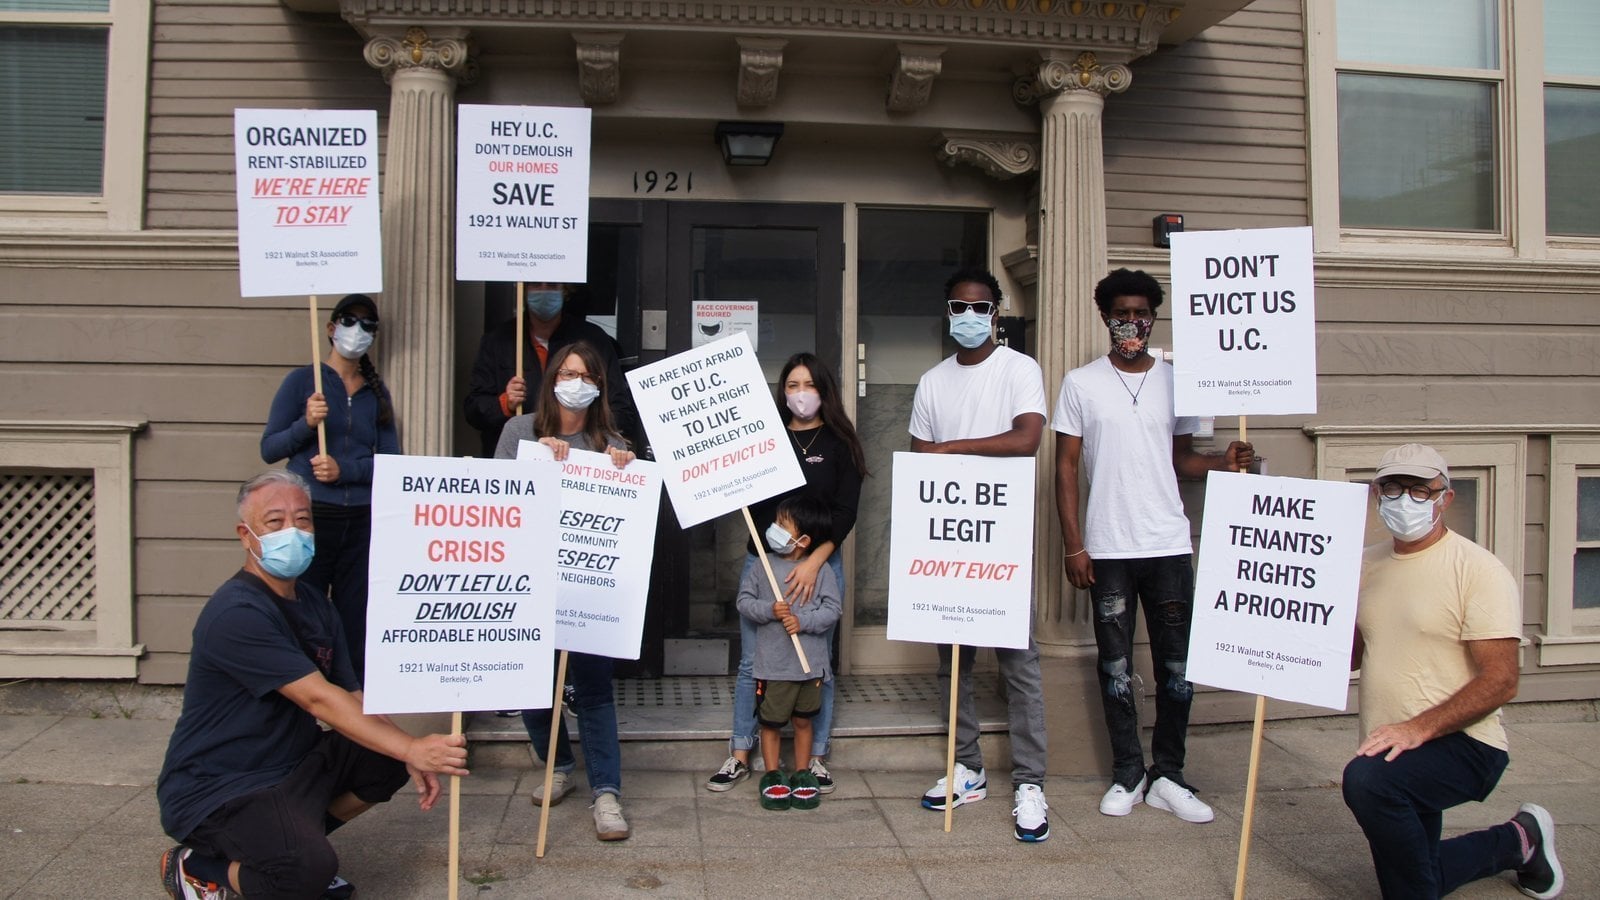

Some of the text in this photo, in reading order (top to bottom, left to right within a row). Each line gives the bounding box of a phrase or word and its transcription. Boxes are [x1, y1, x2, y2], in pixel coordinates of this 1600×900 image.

[246, 127, 367, 146] ORGANIZED
[491, 121, 557, 138] HEY U.C.
[475, 143, 573, 157] DON'T DEMOLISH
[248, 156, 367, 169] RENT-STABILIZED
[489, 161, 558, 174] OUR HOMES
[255, 178, 371, 196] WE'RE HERE
[633, 170, 693, 194] 1921
[492, 182, 554, 206] SAVE
[277, 206, 352, 224] TO STAY
[469, 215, 578, 229] 1921 WALNUT ST
[265, 251, 283, 259] 1921
[310, 250, 318, 258] St
[529, 252, 566, 260] Association
[1205, 255, 1279, 279] DON'T
[1190, 290, 1296, 316] EVICT US
[1219, 328, 1267, 351] U.C.
[638, 346, 743, 390] WE ARE NOT AFRAID
[671, 373, 726, 400] OF U.C.
[1198, 380, 1216, 388] 1921
[1243, 379, 1251, 387] St
[1252, 379, 1292, 387] Association
[659, 383, 750, 423] WE HAVE A RIGHT
[682, 406, 741, 437] TO LIVE
[672, 420, 765, 460] IN BERKELEY TOO
[682, 438, 775, 482] DON'T EVICT US
[402, 476, 535, 496] BAY AREA IS IN A
[593, 468, 646, 486] DISPLACE
[694, 466, 778, 500] 1921 Walnut St Association
[561, 479, 637, 499] ERABLE TENANTS
[919, 480, 1007, 506] U.C. BE
[415, 504, 521, 528] HOUSING
[1252, 494, 1316, 520] MAKE
[560, 510, 625, 533] ESPECT
[929, 518, 996, 543] LEGIT
[562, 532, 618, 549] COMMUNITY
[1229, 525, 1332, 556] TENANTS'
[428, 540, 505, 563] CRISIS
[558, 549, 620, 571] ESPECT
[561, 572, 616, 588] NEIGHBORS
[909, 559, 1019, 581] DON'T EVICT
[1237, 559, 1316, 589] RIGHTS
[398, 574, 531, 592] DON'T LET U.C.
[415, 602, 517, 620] DEMOLISH
[555, 609, 619, 623] nut St Association
[912, 603, 1006, 616] 1921 Walnut St Association
[1214, 590, 1334, 626] A PRIORITY
[555, 619, 577, 627] erkeley,
[942, 614, 965, 623] Berkeley,
[381, 628, 540, 643] AFFORDABLE HOUSING
[1216, 642, 1322, 667] 1921 Walnut St Association
[1247, 658, 1284, 671] Berkeley, CA
[399, 661, 523, 673] 1921 Walnut St Association
[440, 675, 471, 684] Berkeley,
